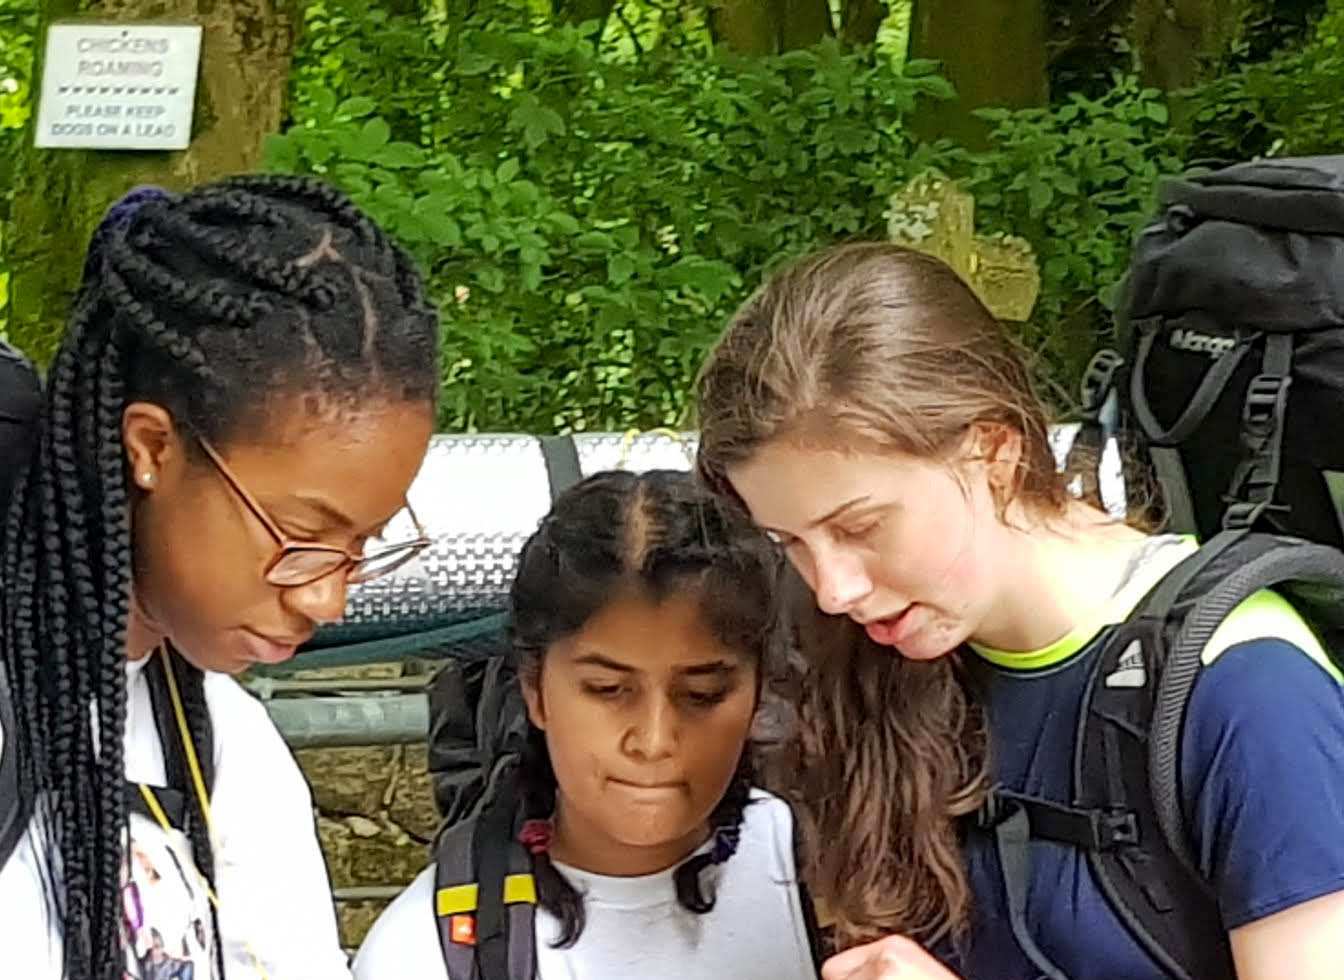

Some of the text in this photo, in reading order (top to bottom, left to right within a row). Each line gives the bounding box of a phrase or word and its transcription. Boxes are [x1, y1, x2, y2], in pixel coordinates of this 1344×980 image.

[77, 38, 169, 54] CHICKENS
[77, 60, 163, 77] ROAMING
[64, 104, 166, 119] PLEASE KEEP
[51, 123, 177, 138] DOGS ON A LEAD
